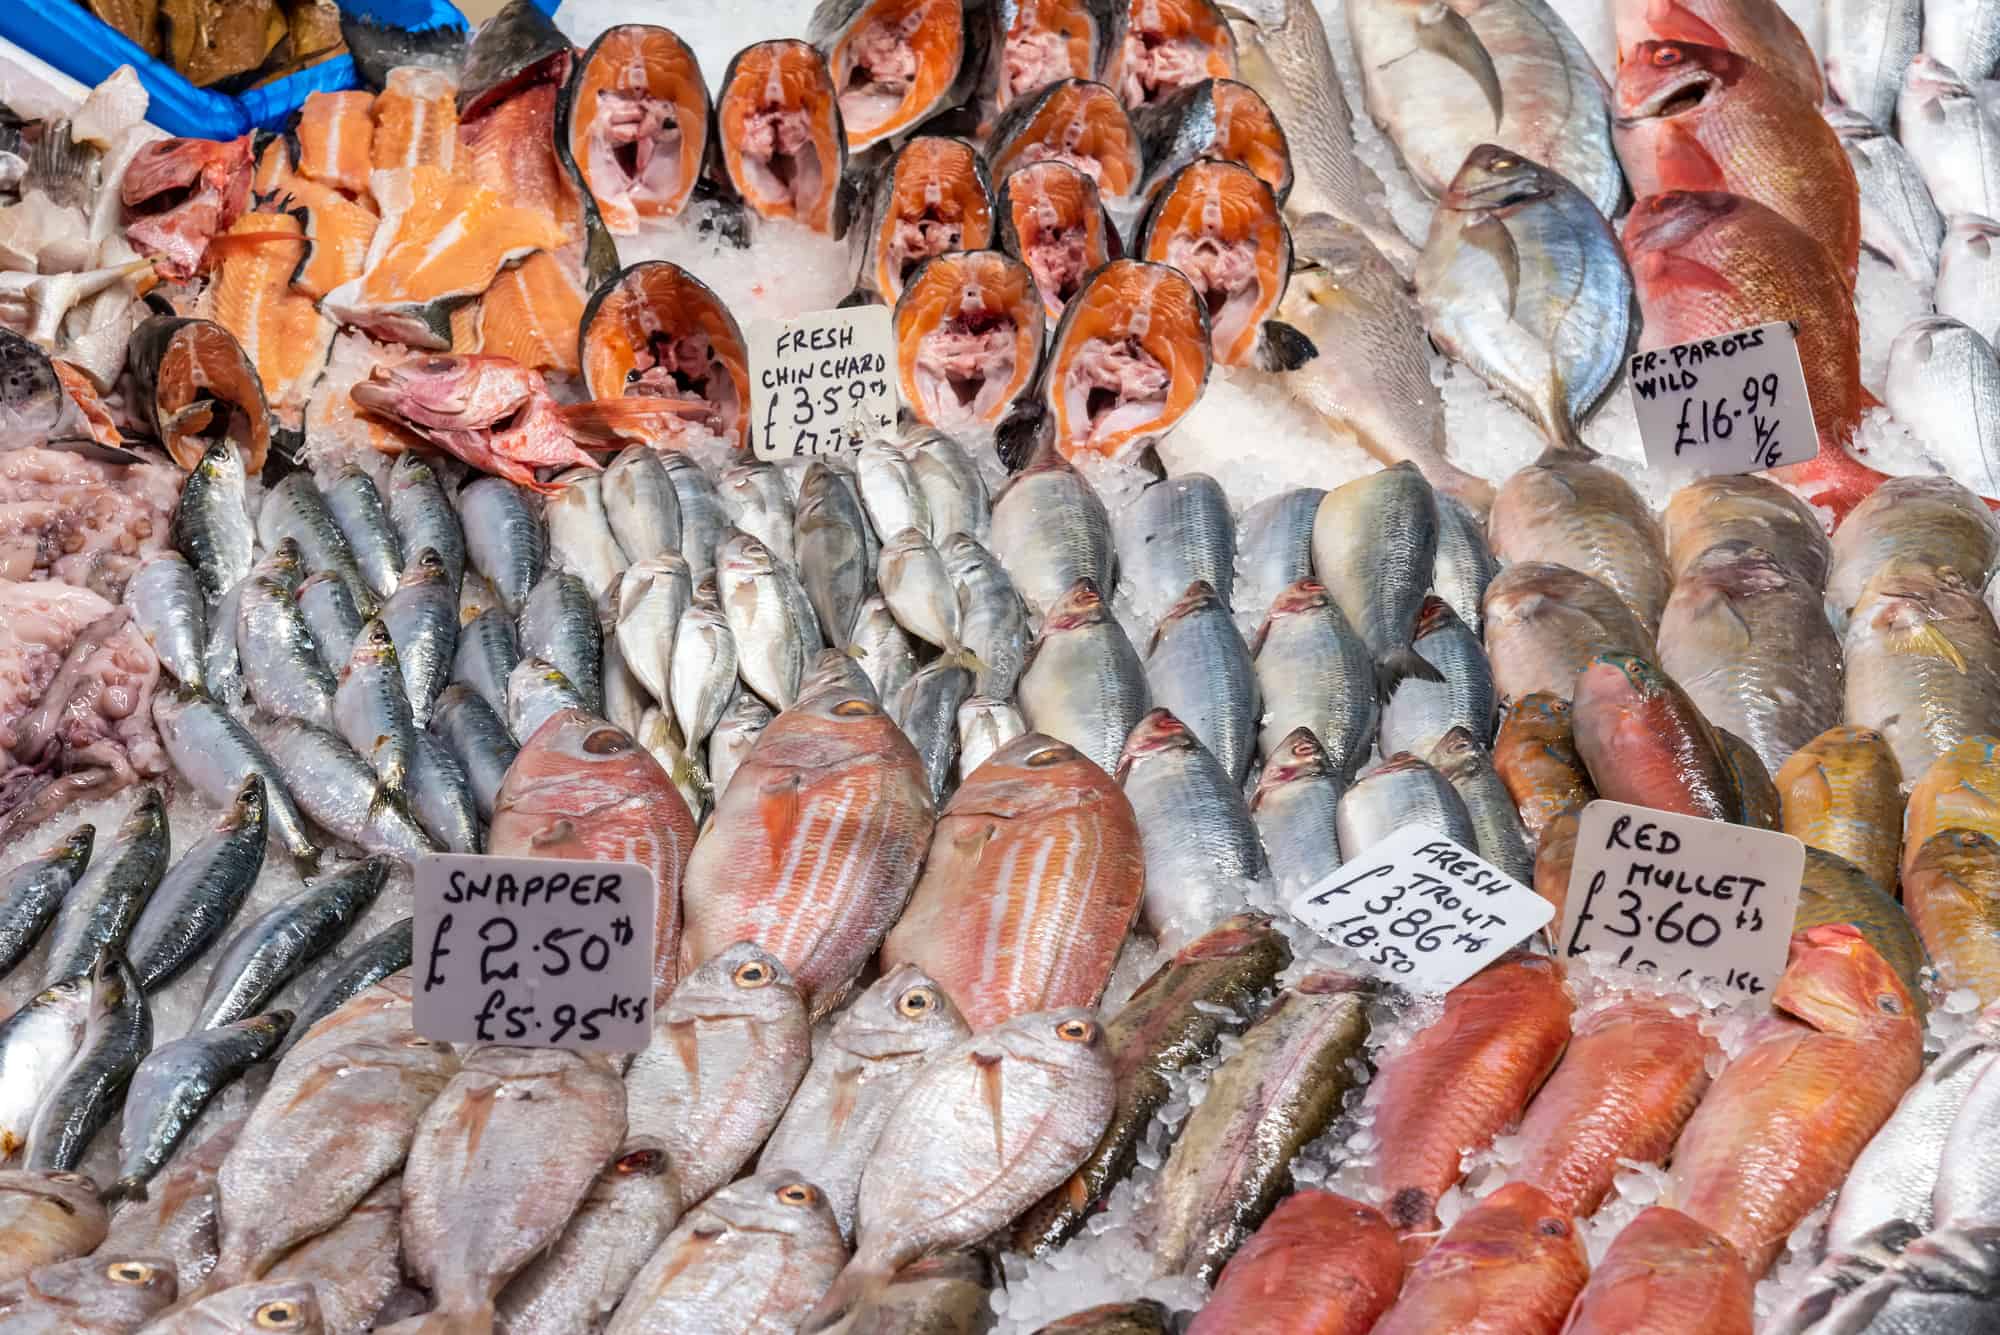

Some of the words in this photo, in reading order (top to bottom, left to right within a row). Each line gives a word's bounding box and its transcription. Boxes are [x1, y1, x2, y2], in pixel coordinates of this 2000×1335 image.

[777, 326, 854, 358] FRESH
[1635, 369, 1698, 400] WILD
[1674, 373, 1779, 456] £16.99
[1605, 815, 1681, 854] RED
[443, 870, 622, 907] SNAPPER
[1413, 842, 1512, 896] FRESH
[1626, 862, 1766, 907] MULLET
[1408, 873, 1507, 929] TROUT
